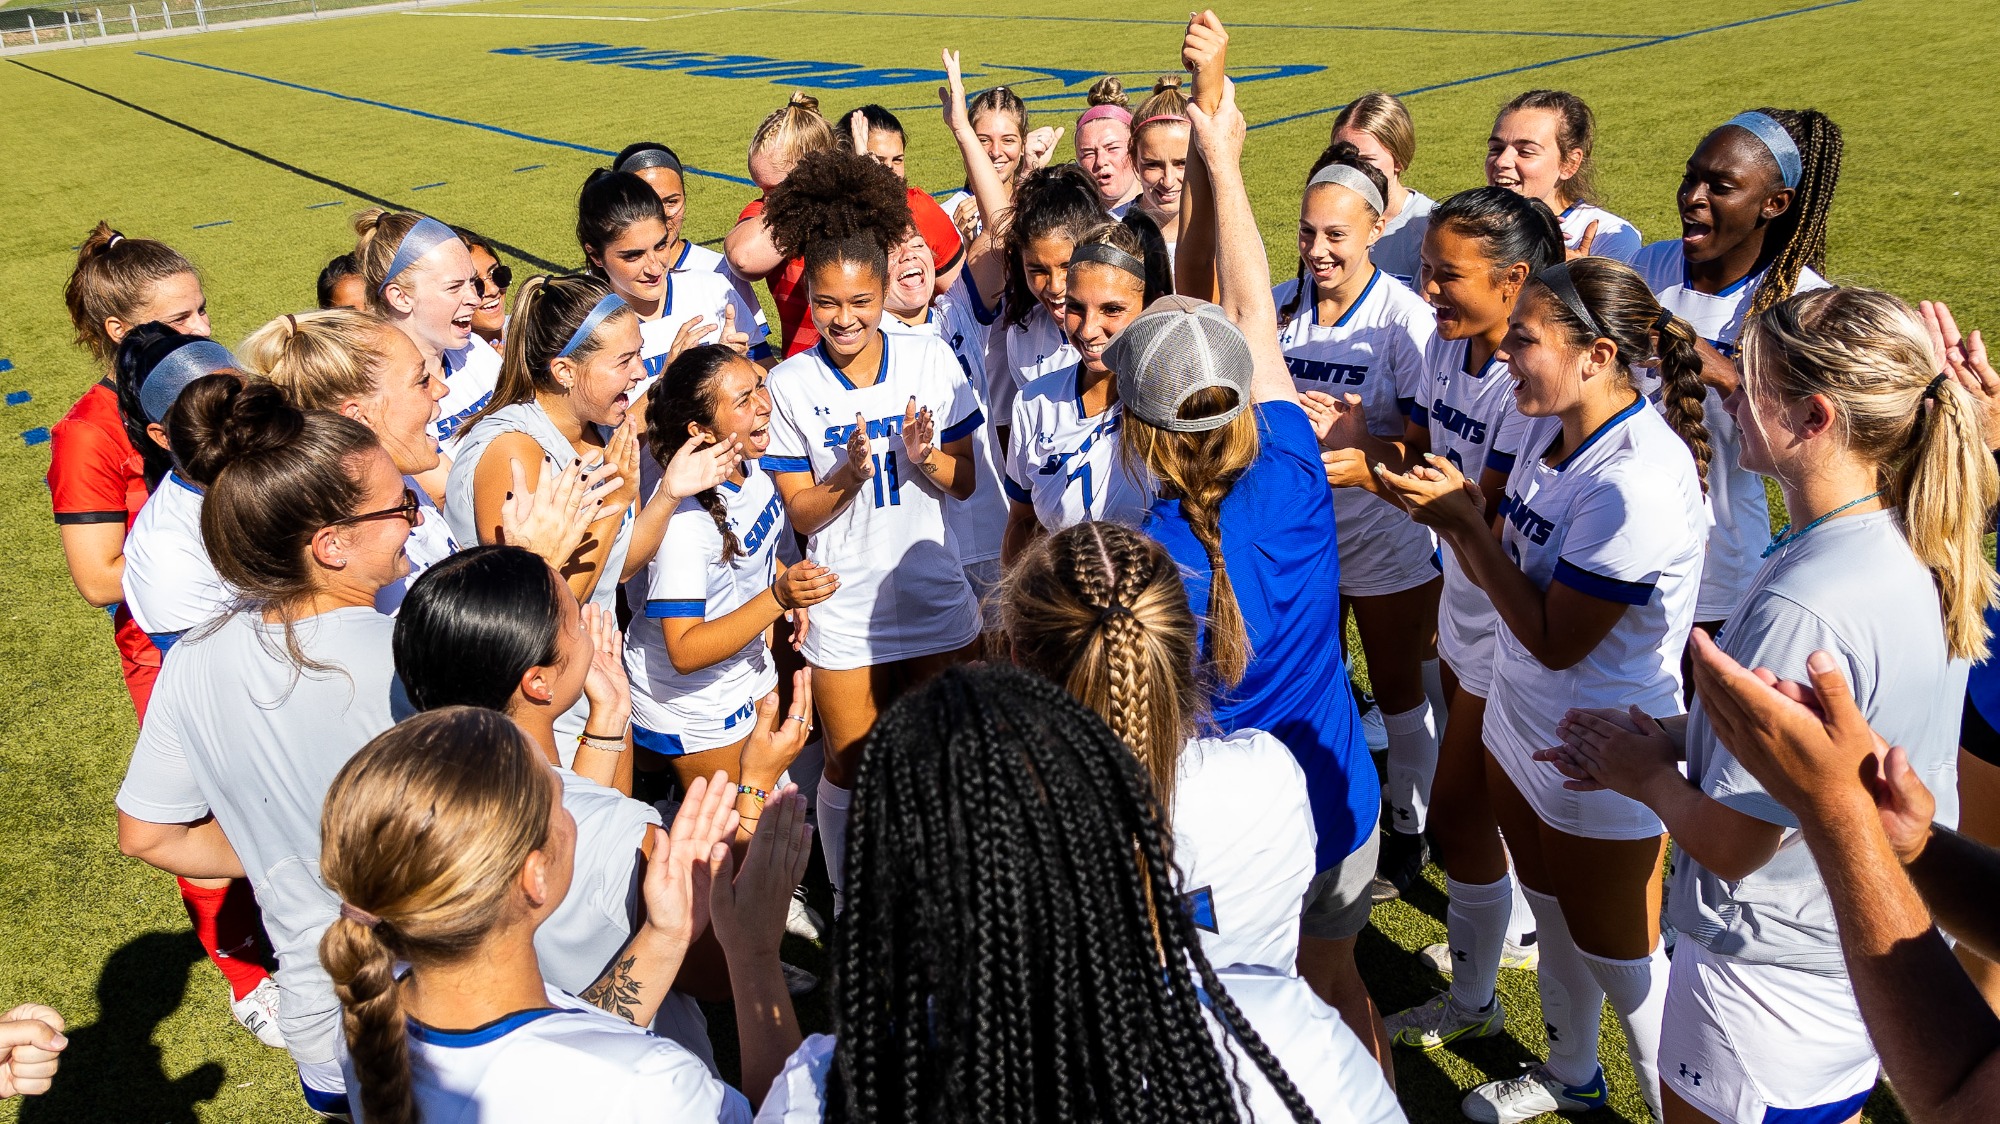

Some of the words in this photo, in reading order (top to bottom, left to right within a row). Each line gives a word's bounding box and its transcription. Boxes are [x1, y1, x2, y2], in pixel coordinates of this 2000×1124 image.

[824, 412, 920, 447] SAINT
[872, 451, 901, 509] 11
[1065, 461, 1094, 512] 7
[743, 491, 784, 557] SAINT
